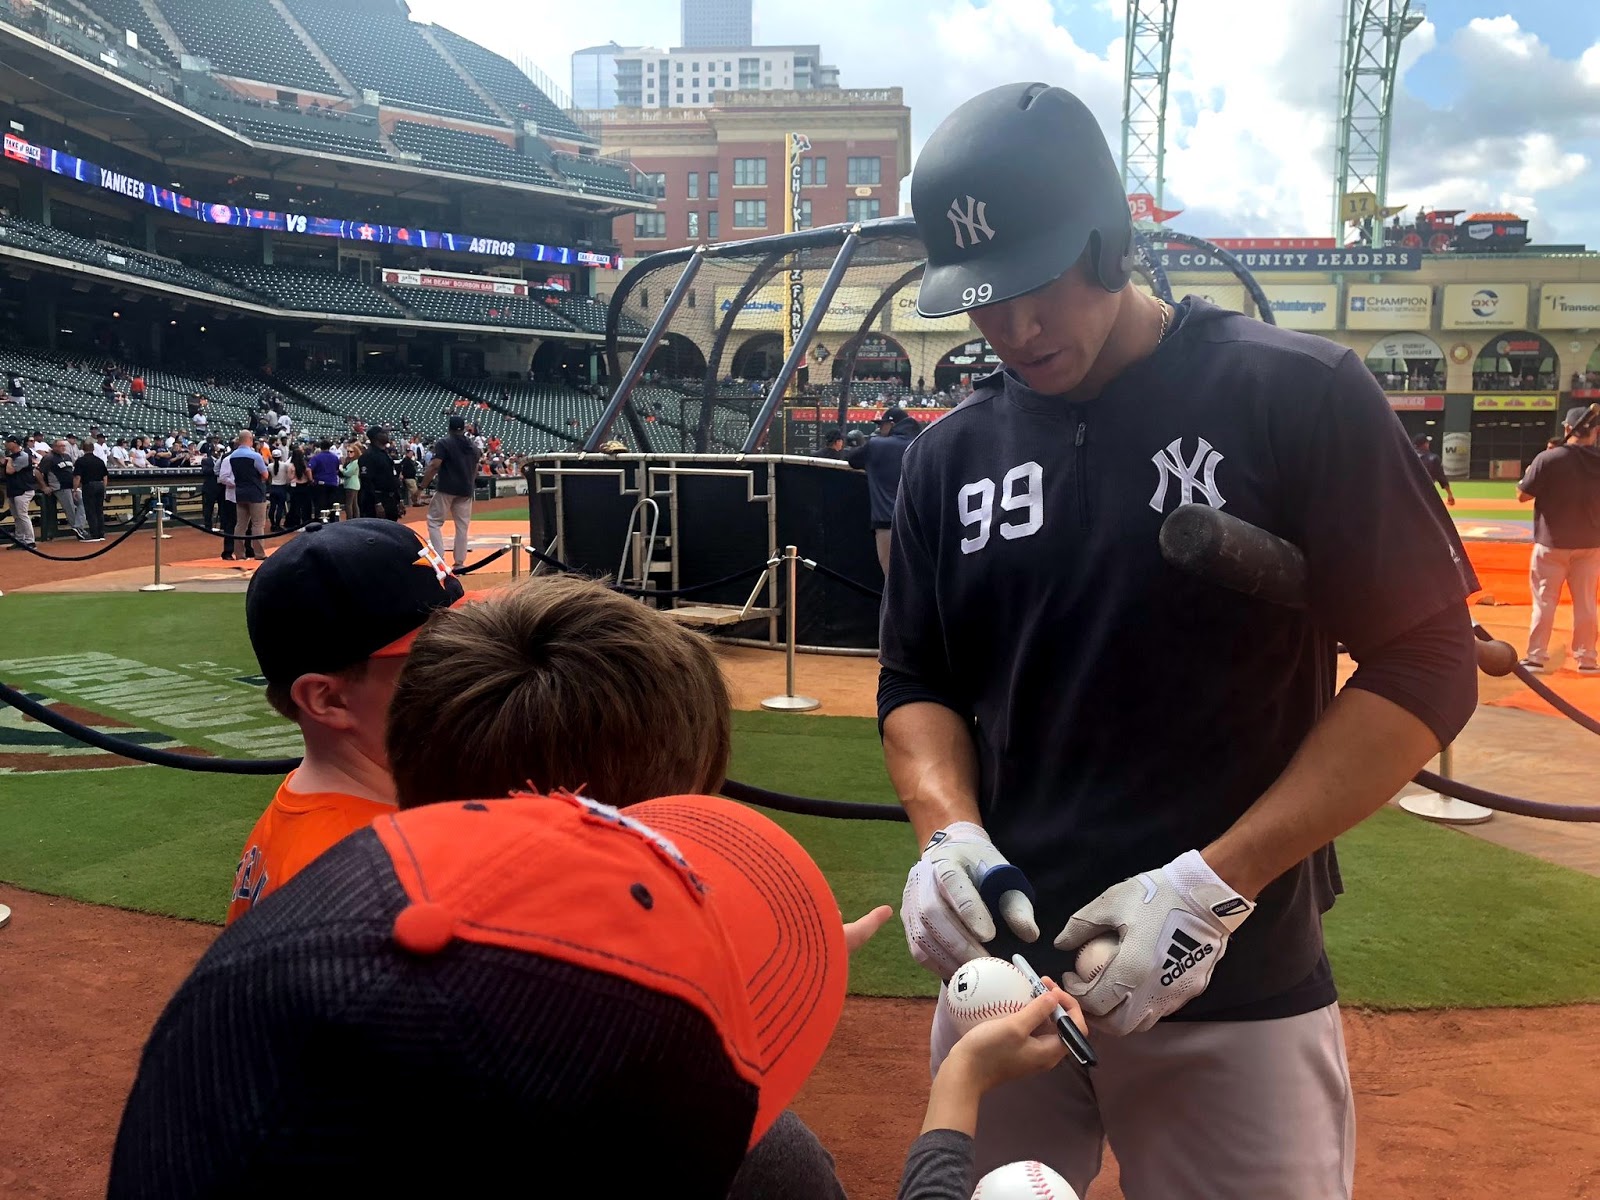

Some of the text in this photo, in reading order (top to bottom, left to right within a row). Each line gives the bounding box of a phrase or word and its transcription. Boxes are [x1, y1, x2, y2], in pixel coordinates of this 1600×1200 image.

[100, 167, 145, 199] YANKEES
[1349, 199, 1368, 212] 17
[286, 213, 308, 232] VS
[469, 237, 515, 256] ASTROS
[1179, 253, 1308, 266] COMUNITY
[1317, 253, 1409, 266] LEADERS
[453, 281, 480, 289] BOURBON
[961, 283, 993, 306] 99
[1366, 296, 1428, 306] CHAMPION
[957, 461, 1044, 555] 99
[1160, 943, 1214, 987] adidas
